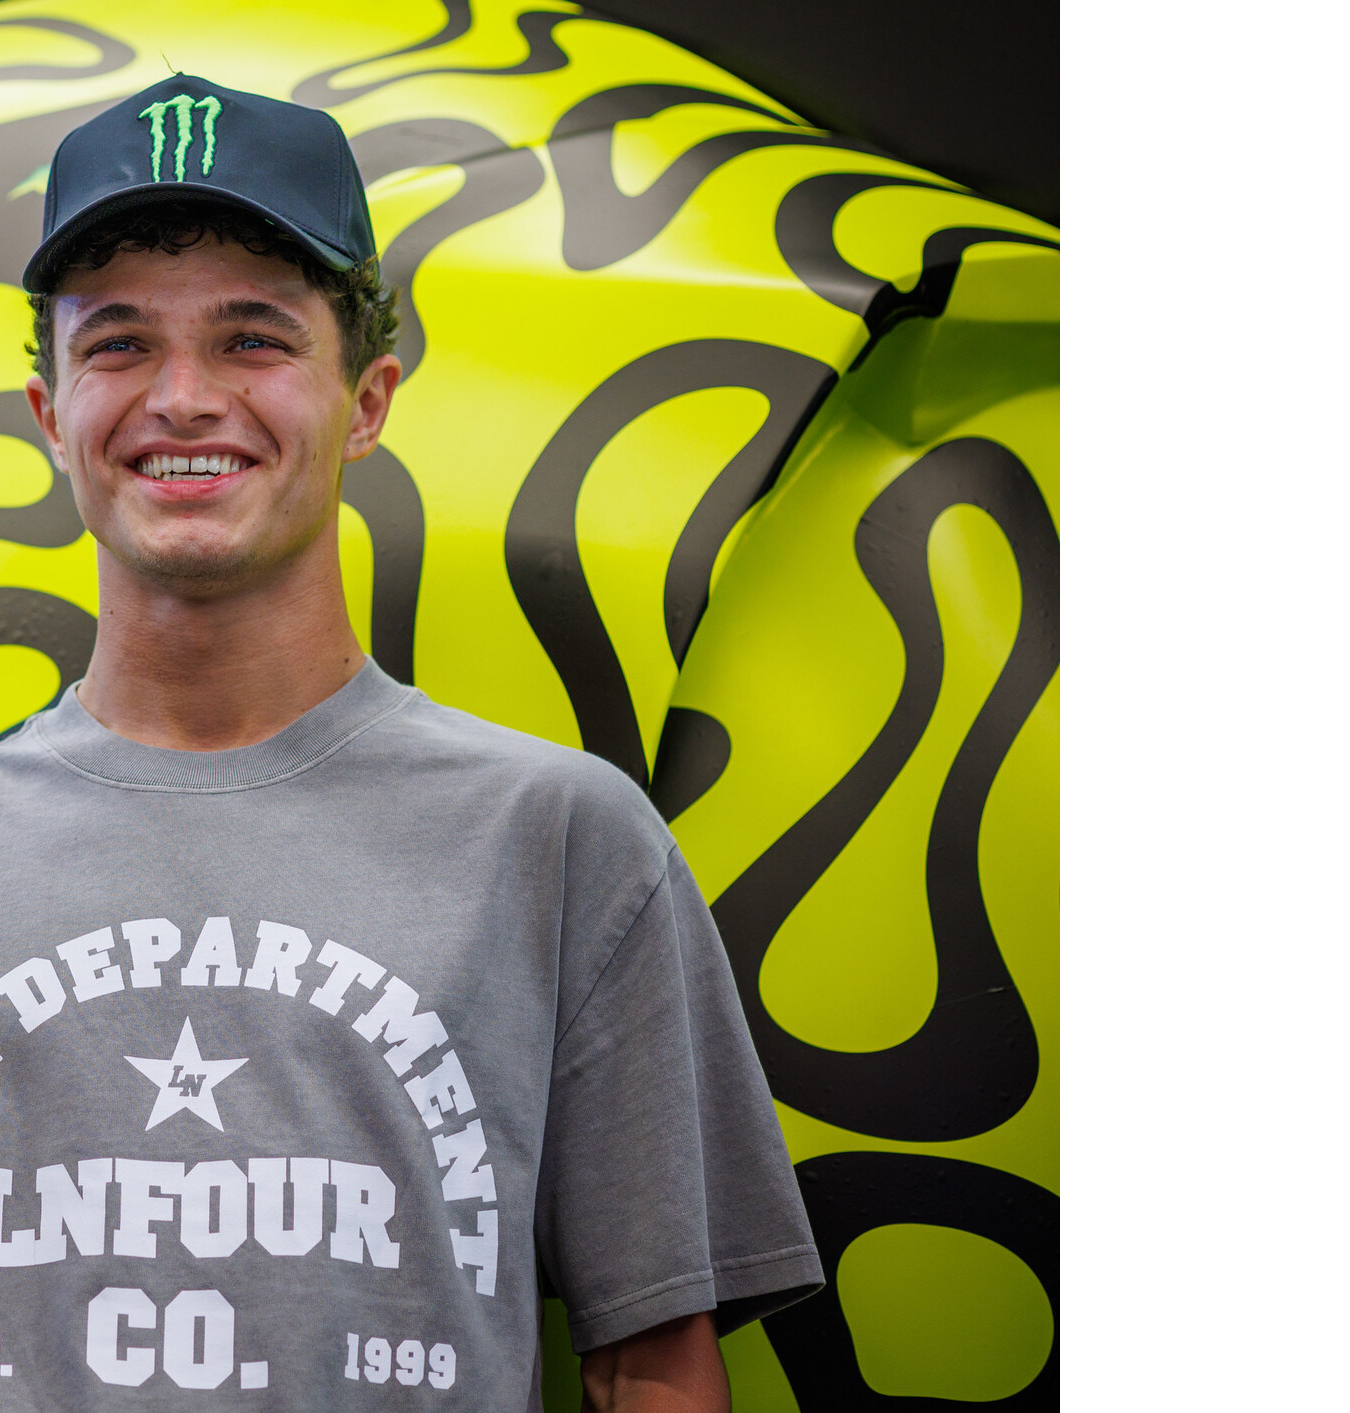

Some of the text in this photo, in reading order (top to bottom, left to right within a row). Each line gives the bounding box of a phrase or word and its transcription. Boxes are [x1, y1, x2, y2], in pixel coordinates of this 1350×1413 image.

[168, 1065, 207, 1097] LN
[86, 1287, 269, 1390] CO.
[344, 1332, 457, 1390] 1999
